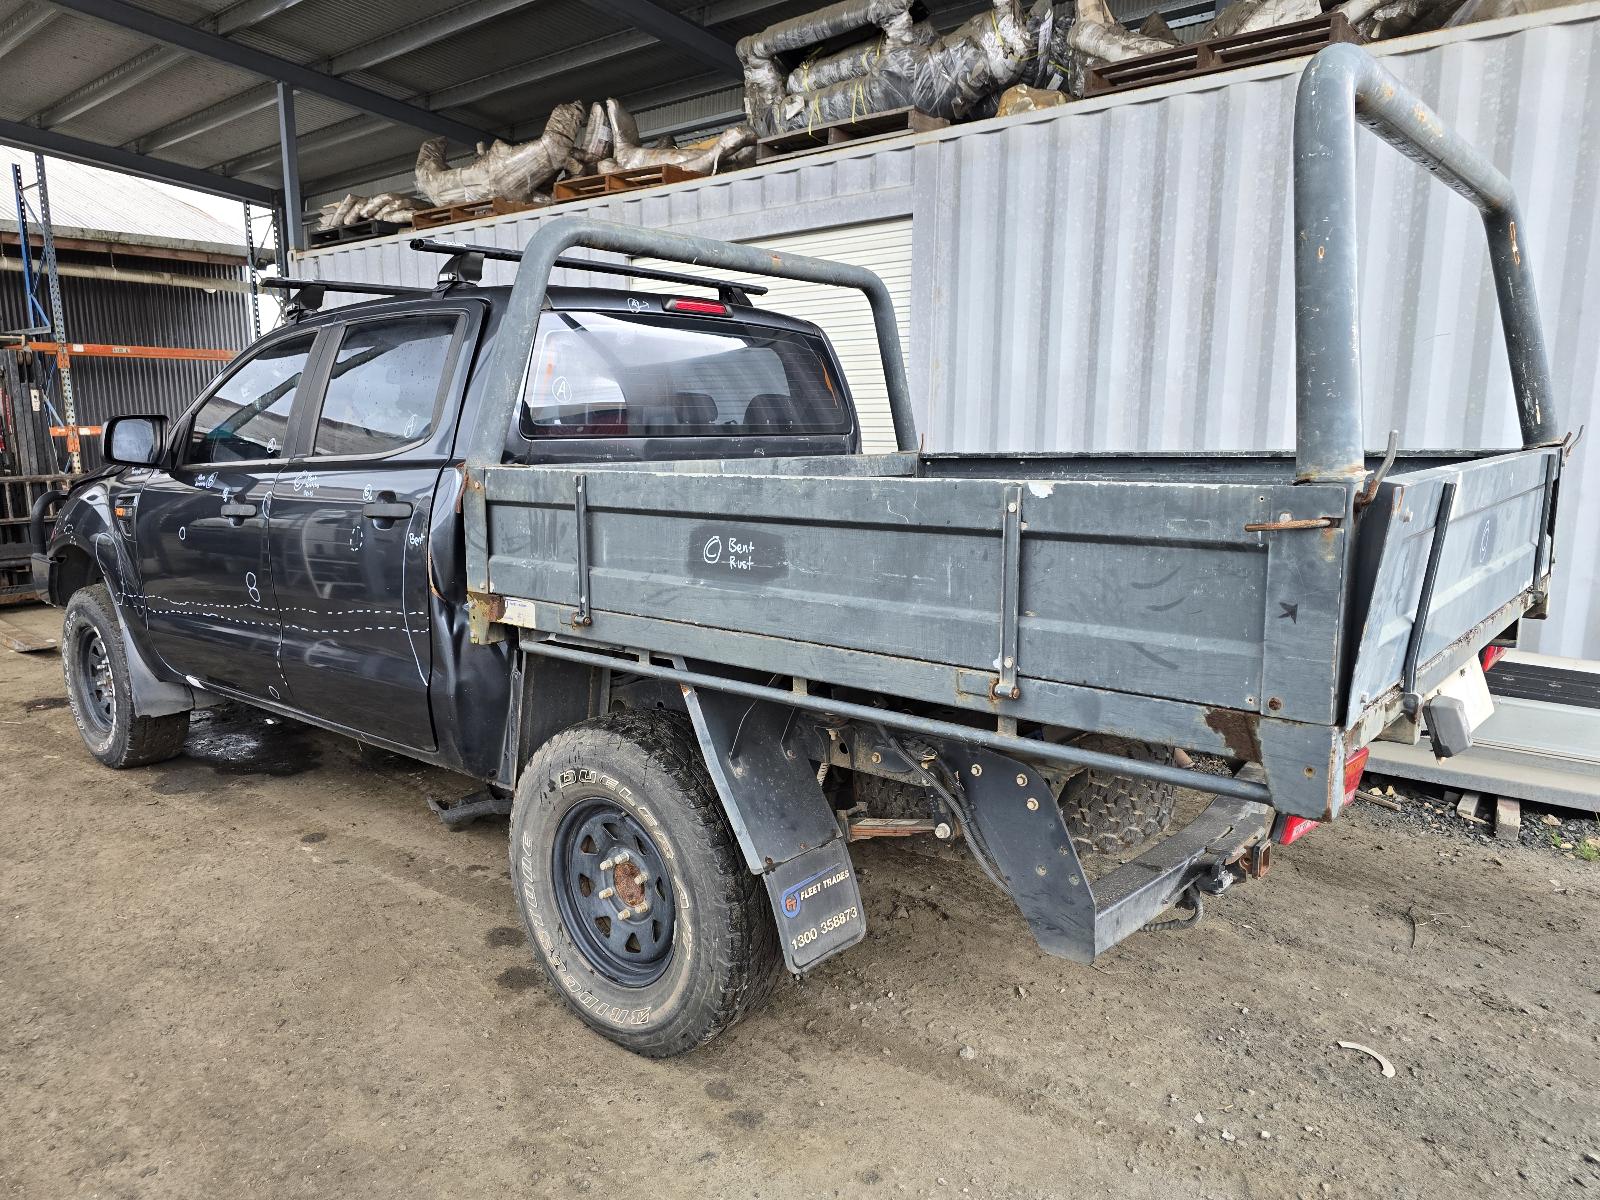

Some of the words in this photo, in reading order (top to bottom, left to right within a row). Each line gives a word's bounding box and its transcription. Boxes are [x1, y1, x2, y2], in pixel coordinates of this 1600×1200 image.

[556, 380, 568, 401] A
[728, 537, 755, 554] Bent
[729, 555, 755, 570] Rust
[801, 882, 821, 901] FLEET
[823, 869, 850, 889] TRADES
[522, 831, 652, 1025] BRIDGESTONE
[791, 927, 818, 950] 1300
[820, 906, 858, 935] 358873
